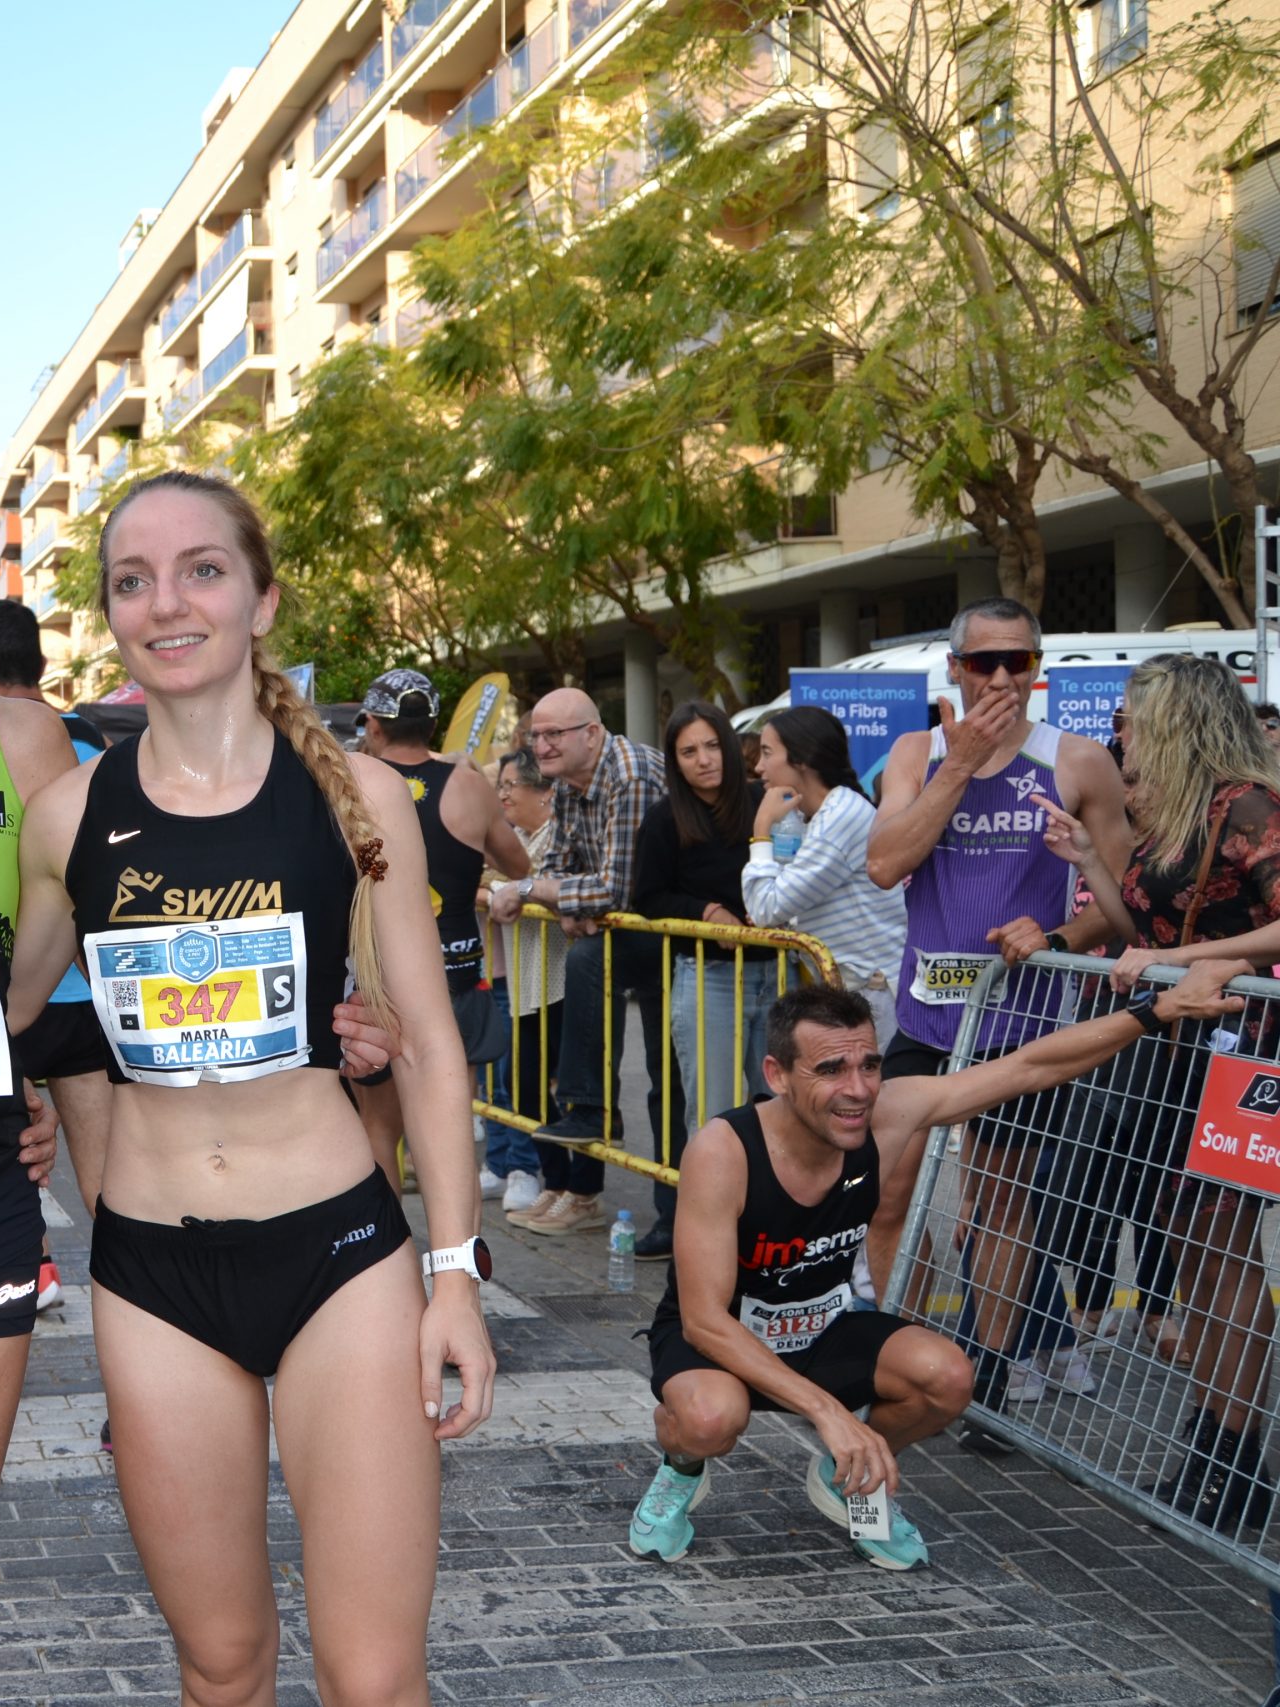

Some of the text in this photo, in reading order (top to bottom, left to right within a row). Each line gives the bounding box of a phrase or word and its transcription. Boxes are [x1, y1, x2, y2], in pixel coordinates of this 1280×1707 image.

[800, 686, 916, 700] Te conectamos
[1059, 679, 1125, 693] Te cone
[832, 703, 888, 718] la Fibra
[1058, 699, 1090, 711] con
[1095, 696, 1110, 711] la
[855, 721, 888, 736] más
[951, 806, 1046, 834] GARBÍ
[963, 847, 991, 856] 1995
[936, 960, 985, 968] SOM ESPO
[928, 969, 978, 985] 3099
[273, 974, 293, 1009] S
[158, 980, 243, 1026] 347
[180, 1028, 229, 1043] MARTA
[780, 1297, 841, 1318] SOM ESPORT
[769, 1314, 824, 1335] 3128
[851, 1516, 878, 1525] MEJOR
